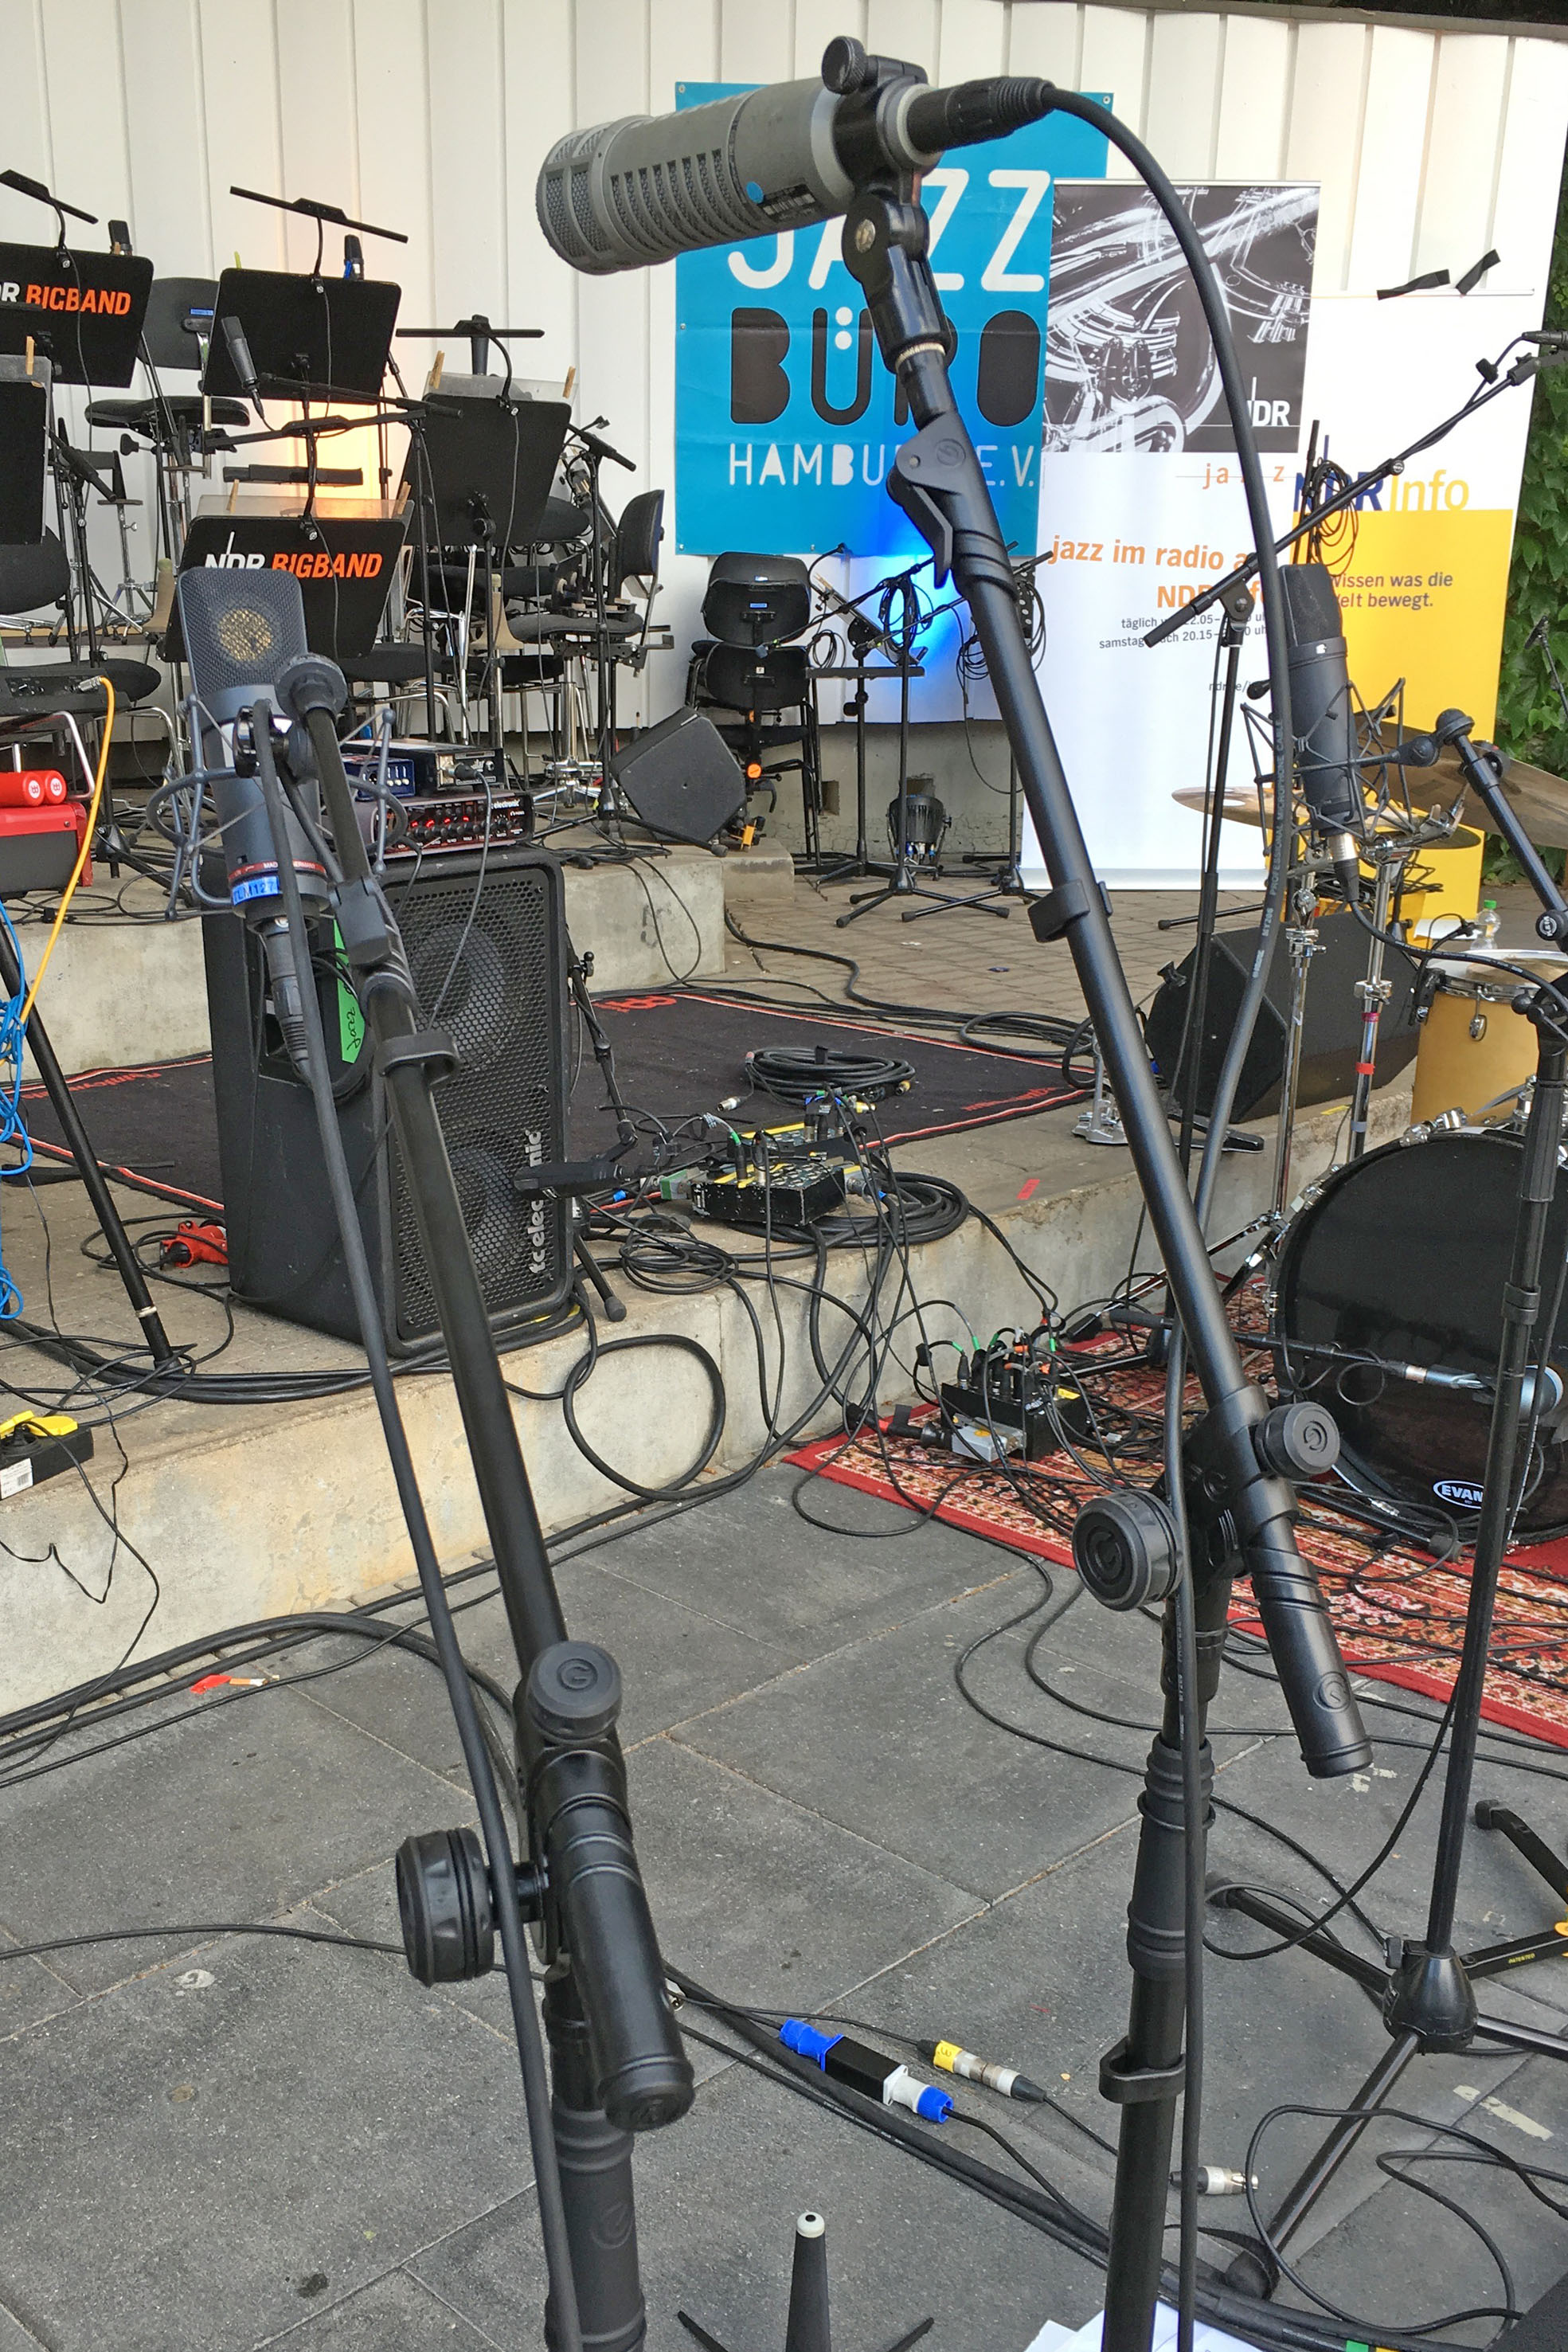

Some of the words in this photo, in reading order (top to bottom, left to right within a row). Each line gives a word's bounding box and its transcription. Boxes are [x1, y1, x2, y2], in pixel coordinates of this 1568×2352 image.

[25, 284, 131, 315] BIGBAND
[1202, 463, 1285, 490] jaz
[1390, 469, 1470, 511] Info
[1047, 535, 1104, 565] jazz
[1112, 539, 1146, 565] im
[1155, 544, 1224, 570] radio
[272, 553, 383, 579] BIGBAND
[1390, 574, 1423, 587] was
[1428, 572, 1453, 586] die
[1337, 593, 1363, 608] elt
[1367, 593, 1434, 611] bewegt.
[1121, 617, 1158, 631] täglich
[233, 879, 276, 902] TLM127
[529, 1249, 545, 1273] tc
[1441, 1484, 1484, 1503] EVAN
